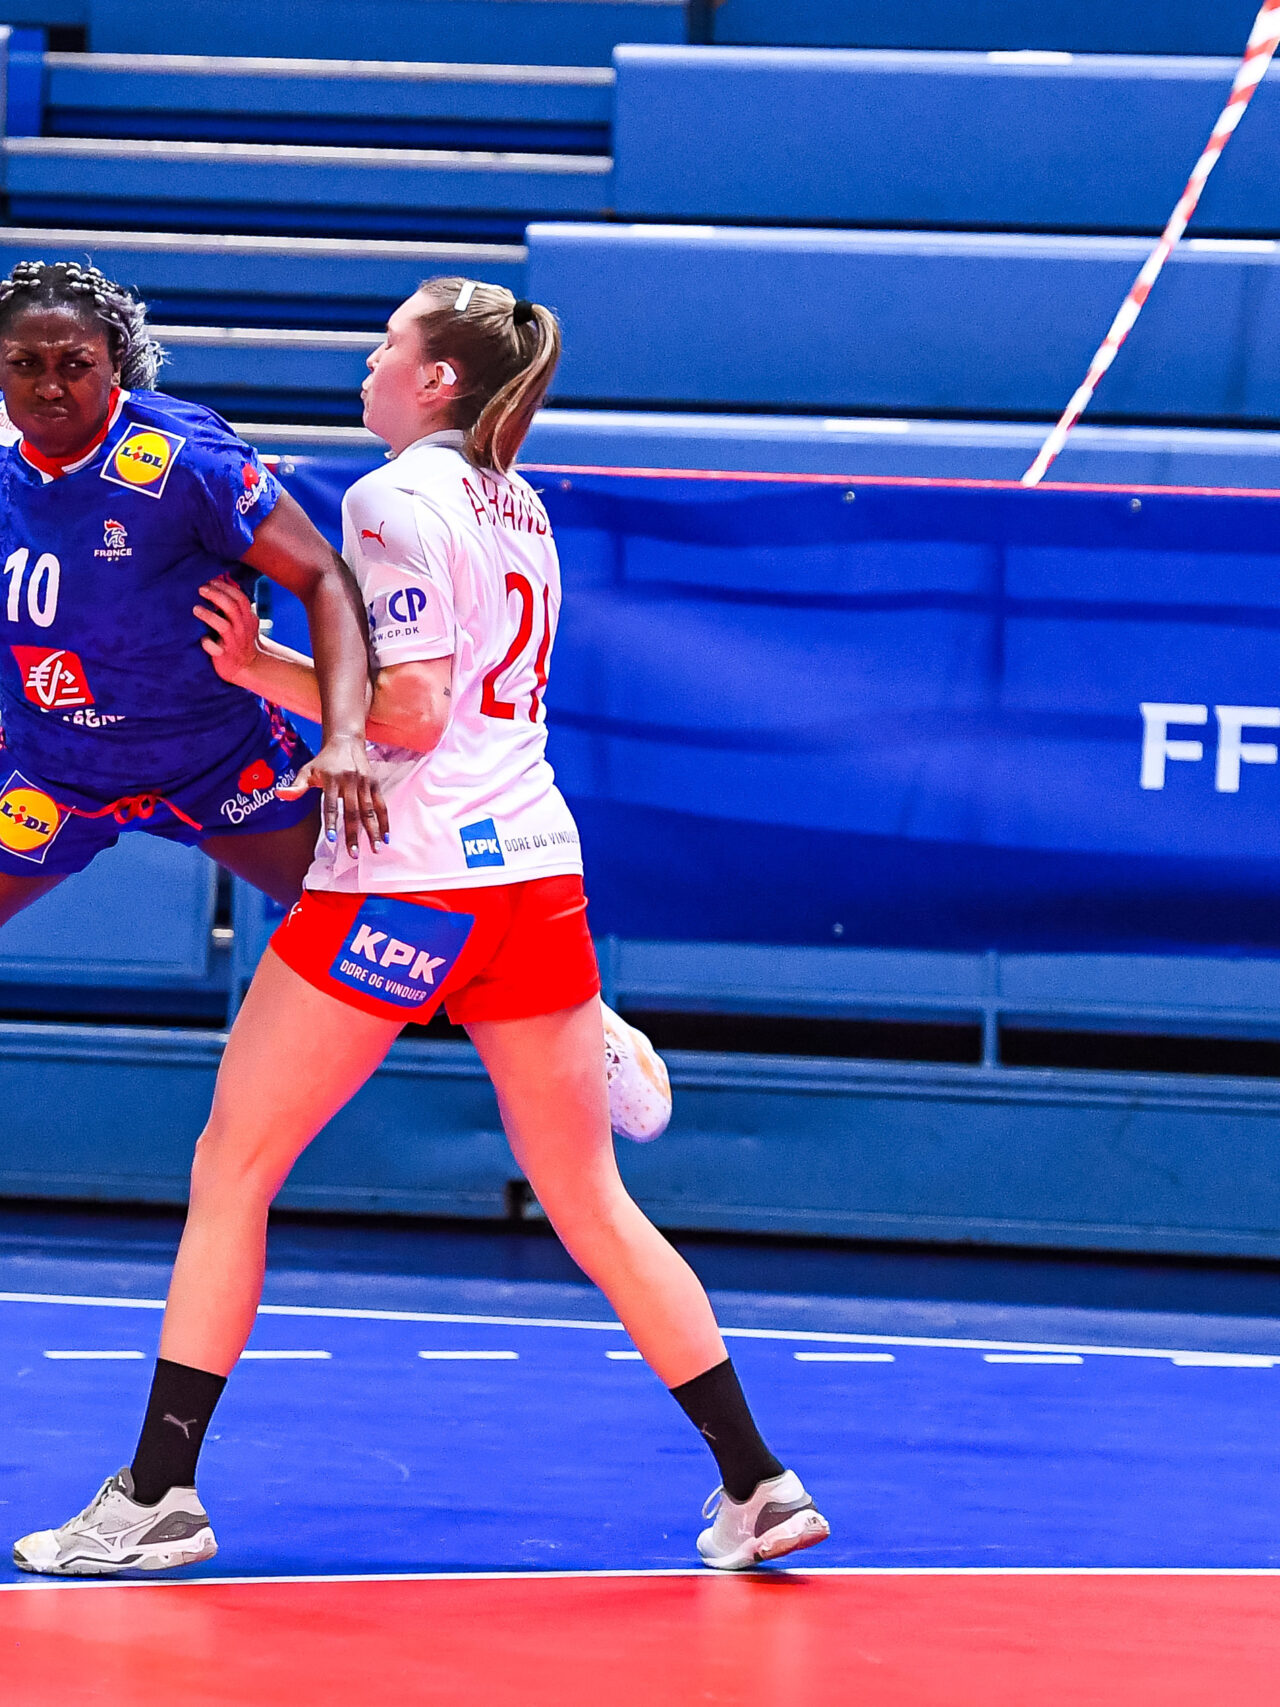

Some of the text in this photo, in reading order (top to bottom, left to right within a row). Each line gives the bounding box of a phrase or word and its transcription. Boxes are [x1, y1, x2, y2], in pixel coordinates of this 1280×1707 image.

[93, 547, 133, 557] FRANCE
[3, 546, 61, 628] 10
[388, 587, 427, 623] CP
[1139, 701, 1280, 794] FF
[464, 838, 500, 856] KPK
[349, 923, 446, 985] KPK
[368, 973, 385, 989] OG
[385, 979, 427, 1001] VINDUER
